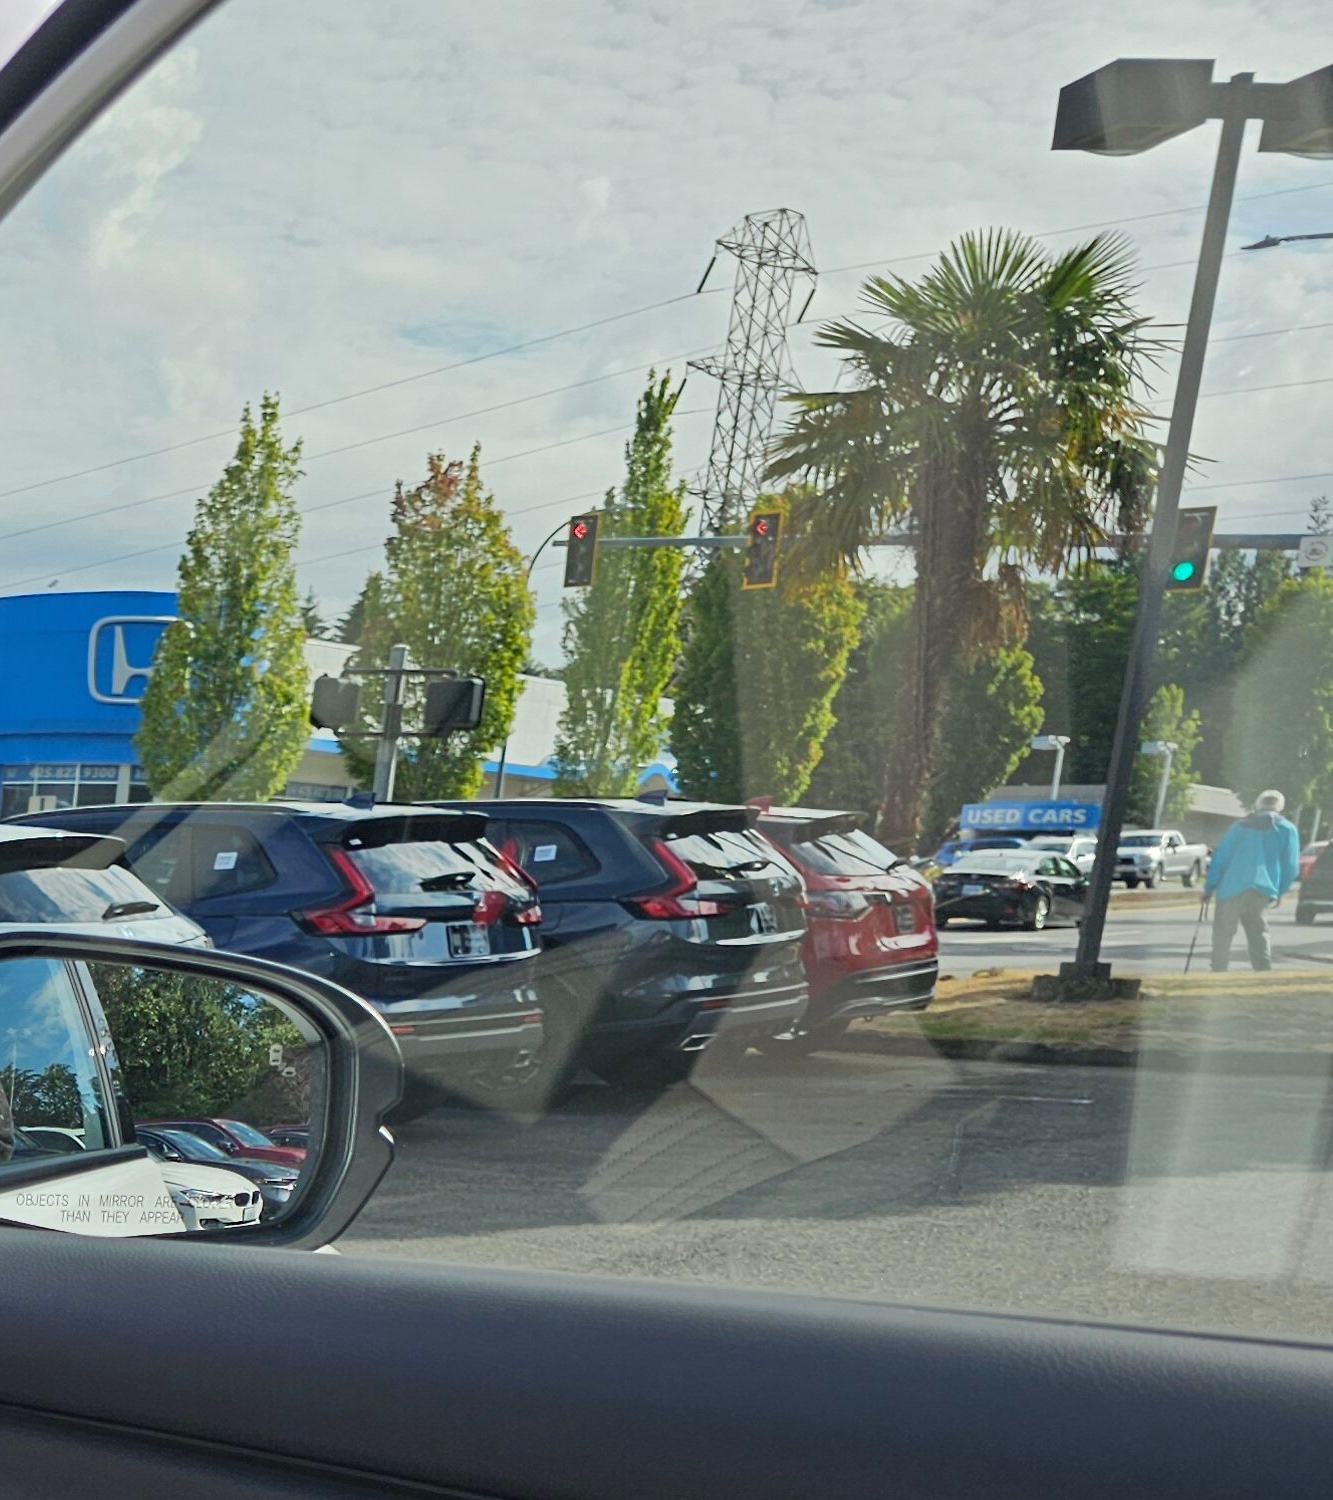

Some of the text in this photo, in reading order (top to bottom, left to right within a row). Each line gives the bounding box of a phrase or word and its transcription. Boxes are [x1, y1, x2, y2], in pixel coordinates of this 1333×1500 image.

[967, 808, 1087, 824] USED CARS
[16, 1193, 69, 1207] OBJECTS
[78, 1194, 90, 1207] IN
[99, 1194, 144, 1208] MIRROR
[154, 1195, 178, 1209] ARE
[61, 1209, 91, 1222] THAN
[101, 1210, 130, 1224] THEY
